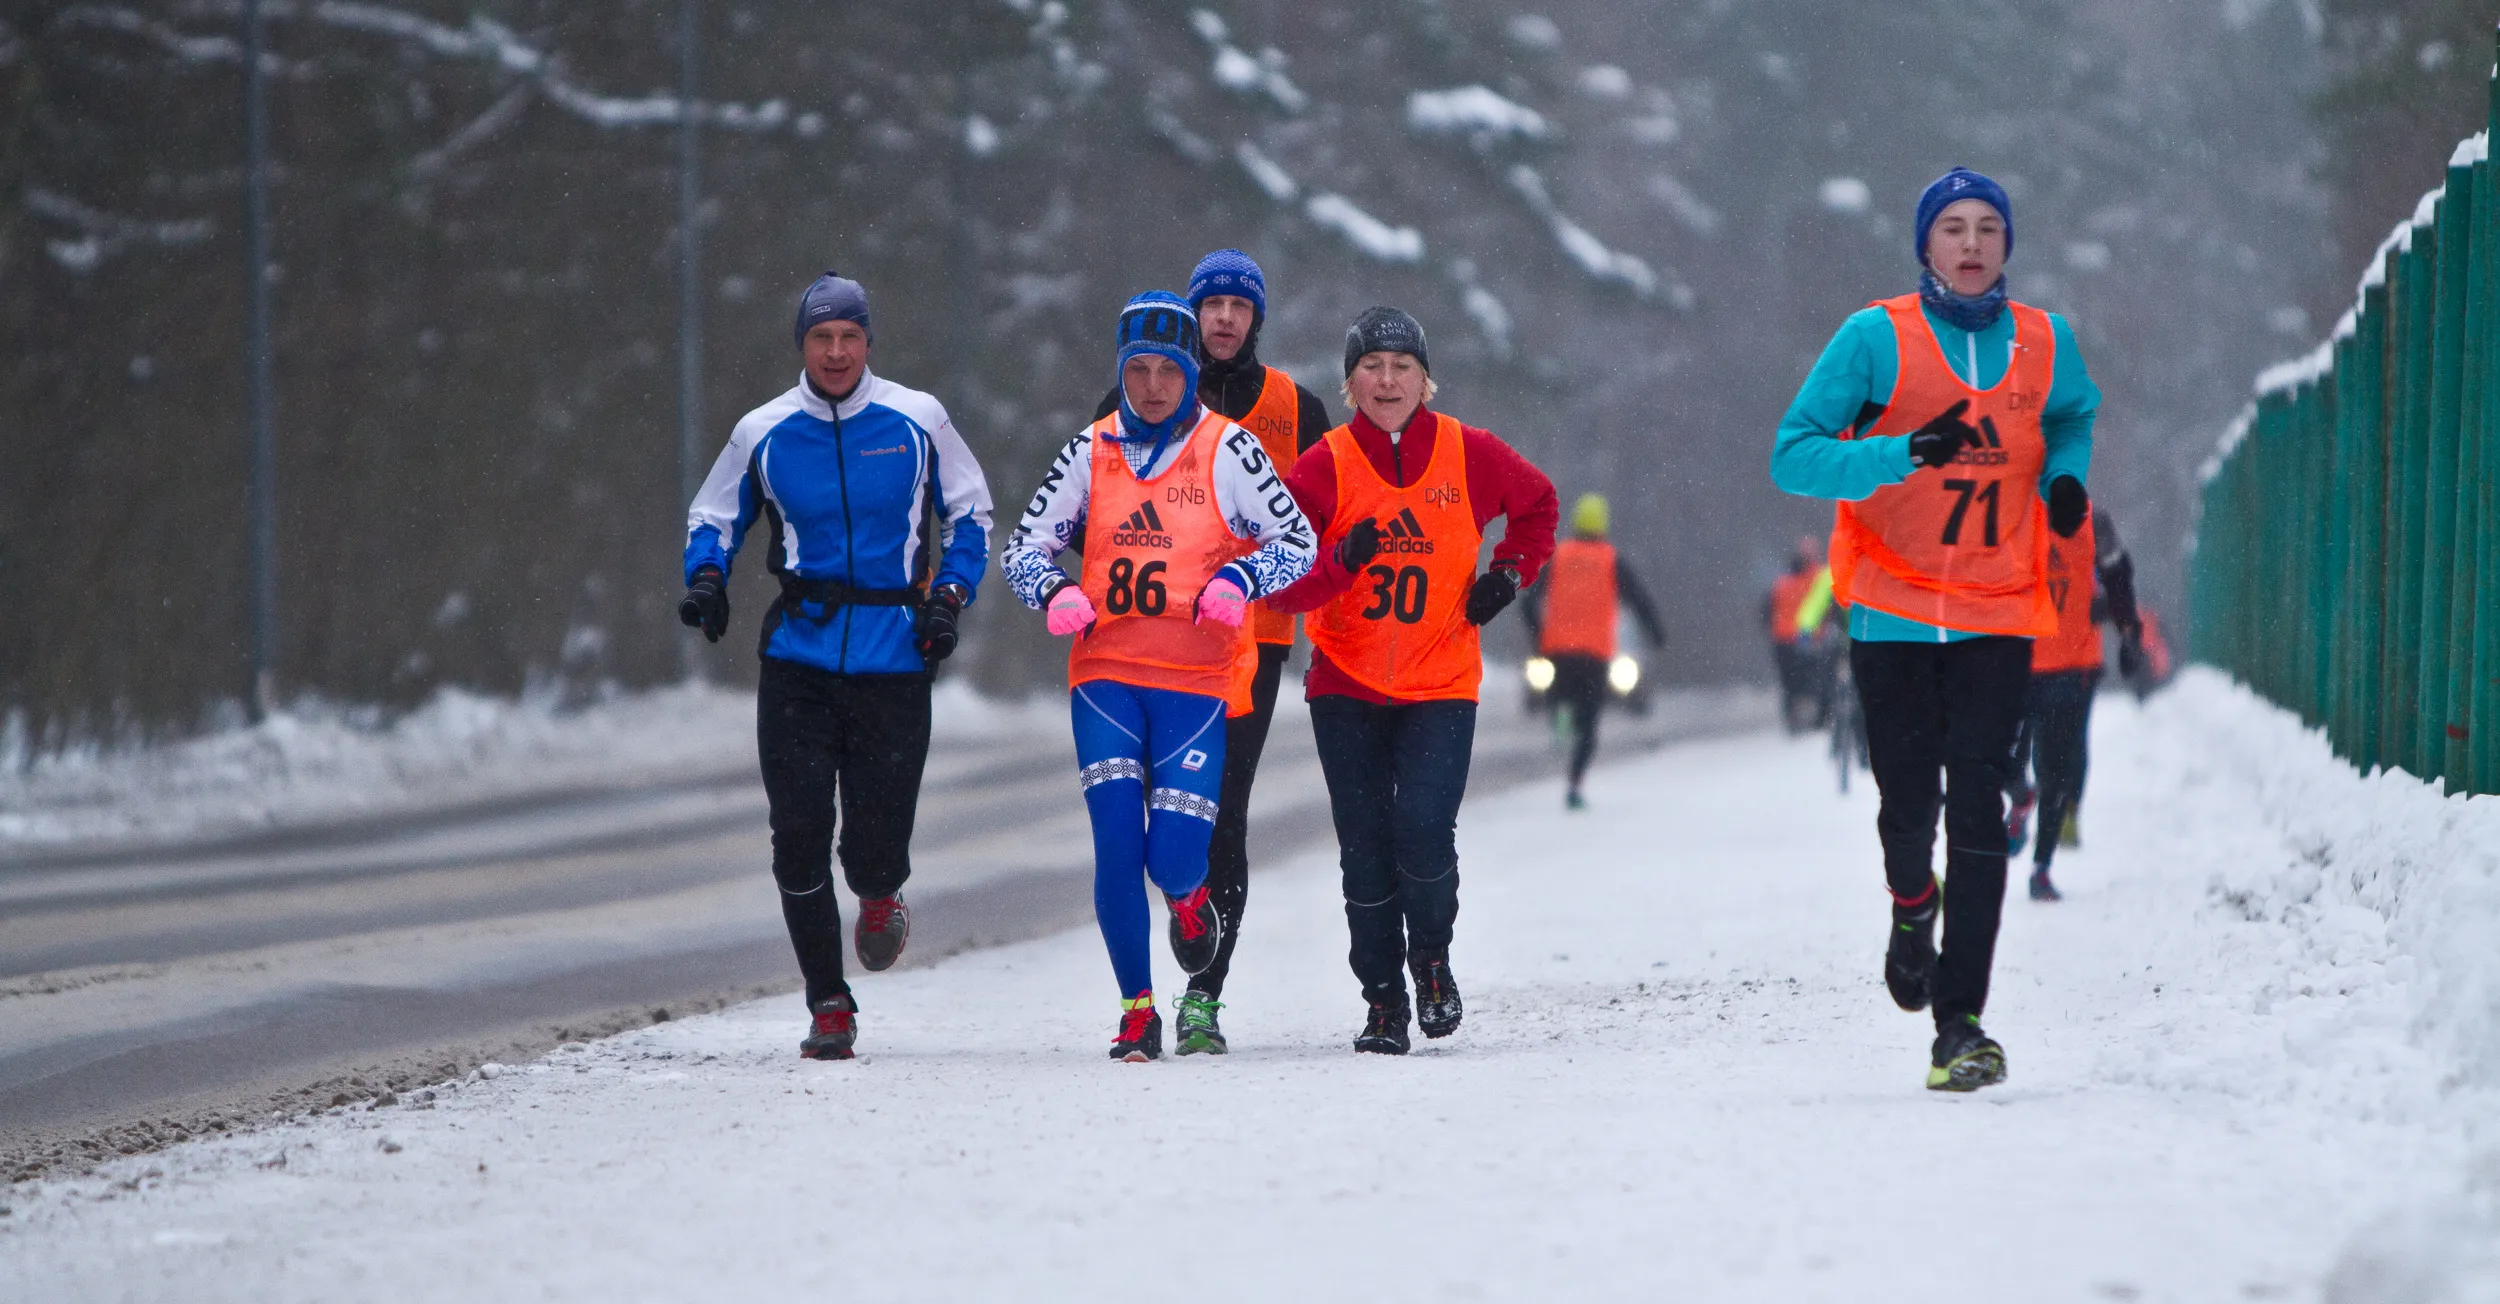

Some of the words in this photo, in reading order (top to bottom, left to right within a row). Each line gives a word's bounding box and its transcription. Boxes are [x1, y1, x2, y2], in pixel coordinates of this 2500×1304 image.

[1257, 415, 1293, 438] DNB
[1167, 483, 1206, 509] DNB
[1425, 482, 1461, 508] DNB
[1941, 479, 2001, 547] 71
[1113, 529, 1173, 549] adidas
[1378, 537, 1434, 554] didas
[1106, 557, 1167, 616] 86
[1362, 564, 1428, 624] 30
